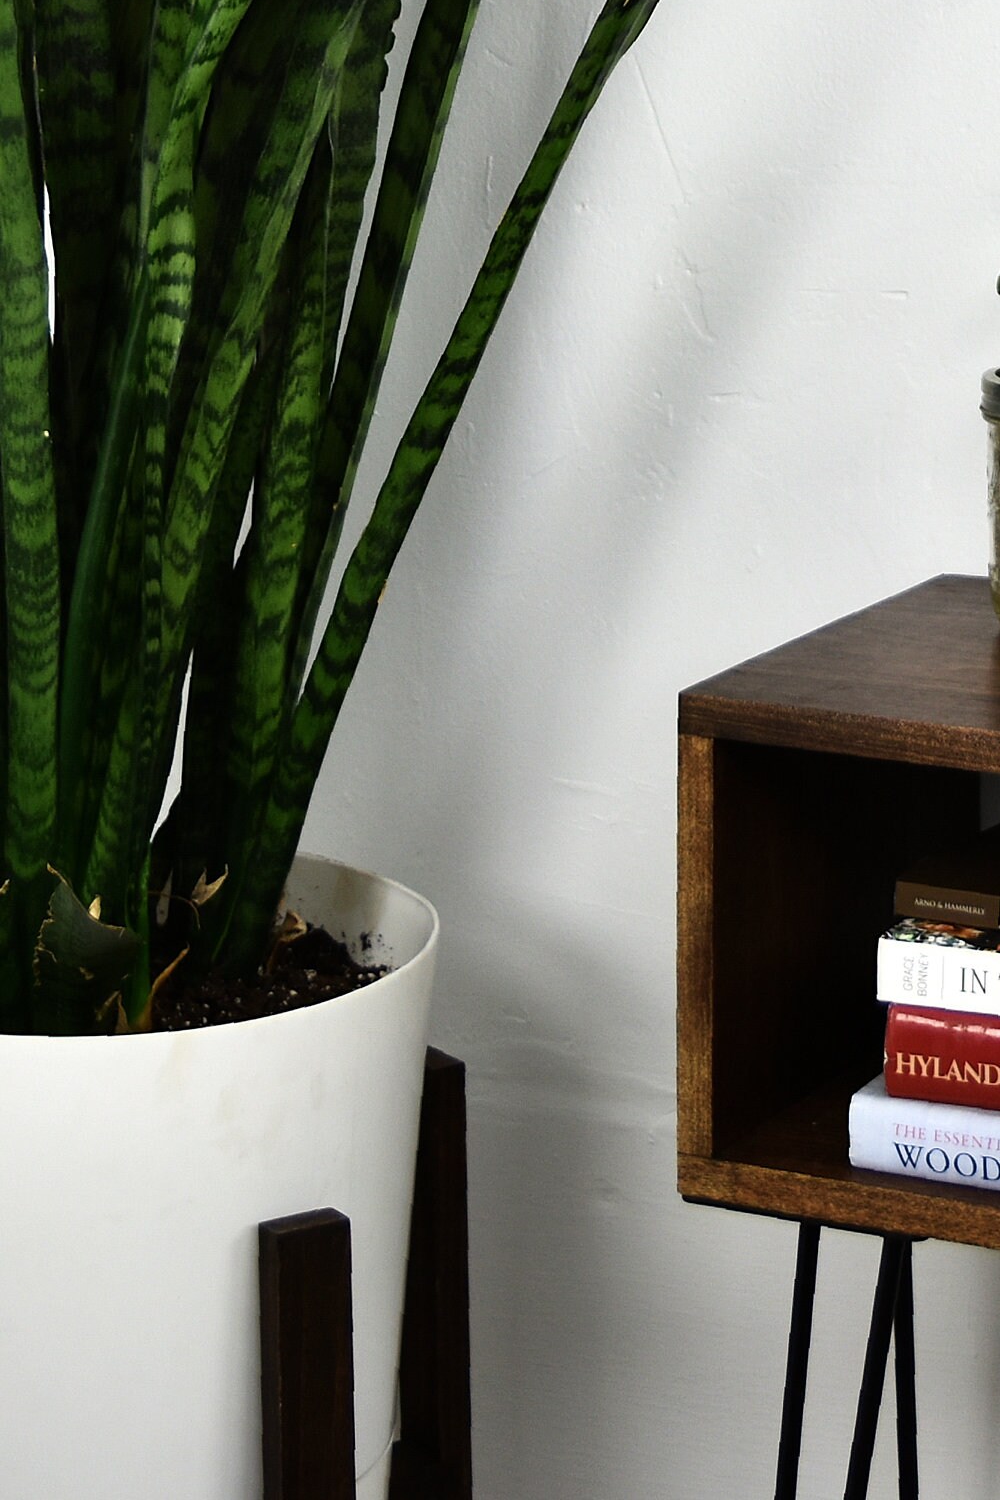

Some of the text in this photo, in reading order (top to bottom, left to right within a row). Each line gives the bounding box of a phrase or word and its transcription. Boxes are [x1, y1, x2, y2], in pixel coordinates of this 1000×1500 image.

[903, 955, 915, 992] GRACE
[917, 952, 930, 997] BONNEY
[960, 967, 988, 995] IN
[893, 1123, 927, 1141] THE
